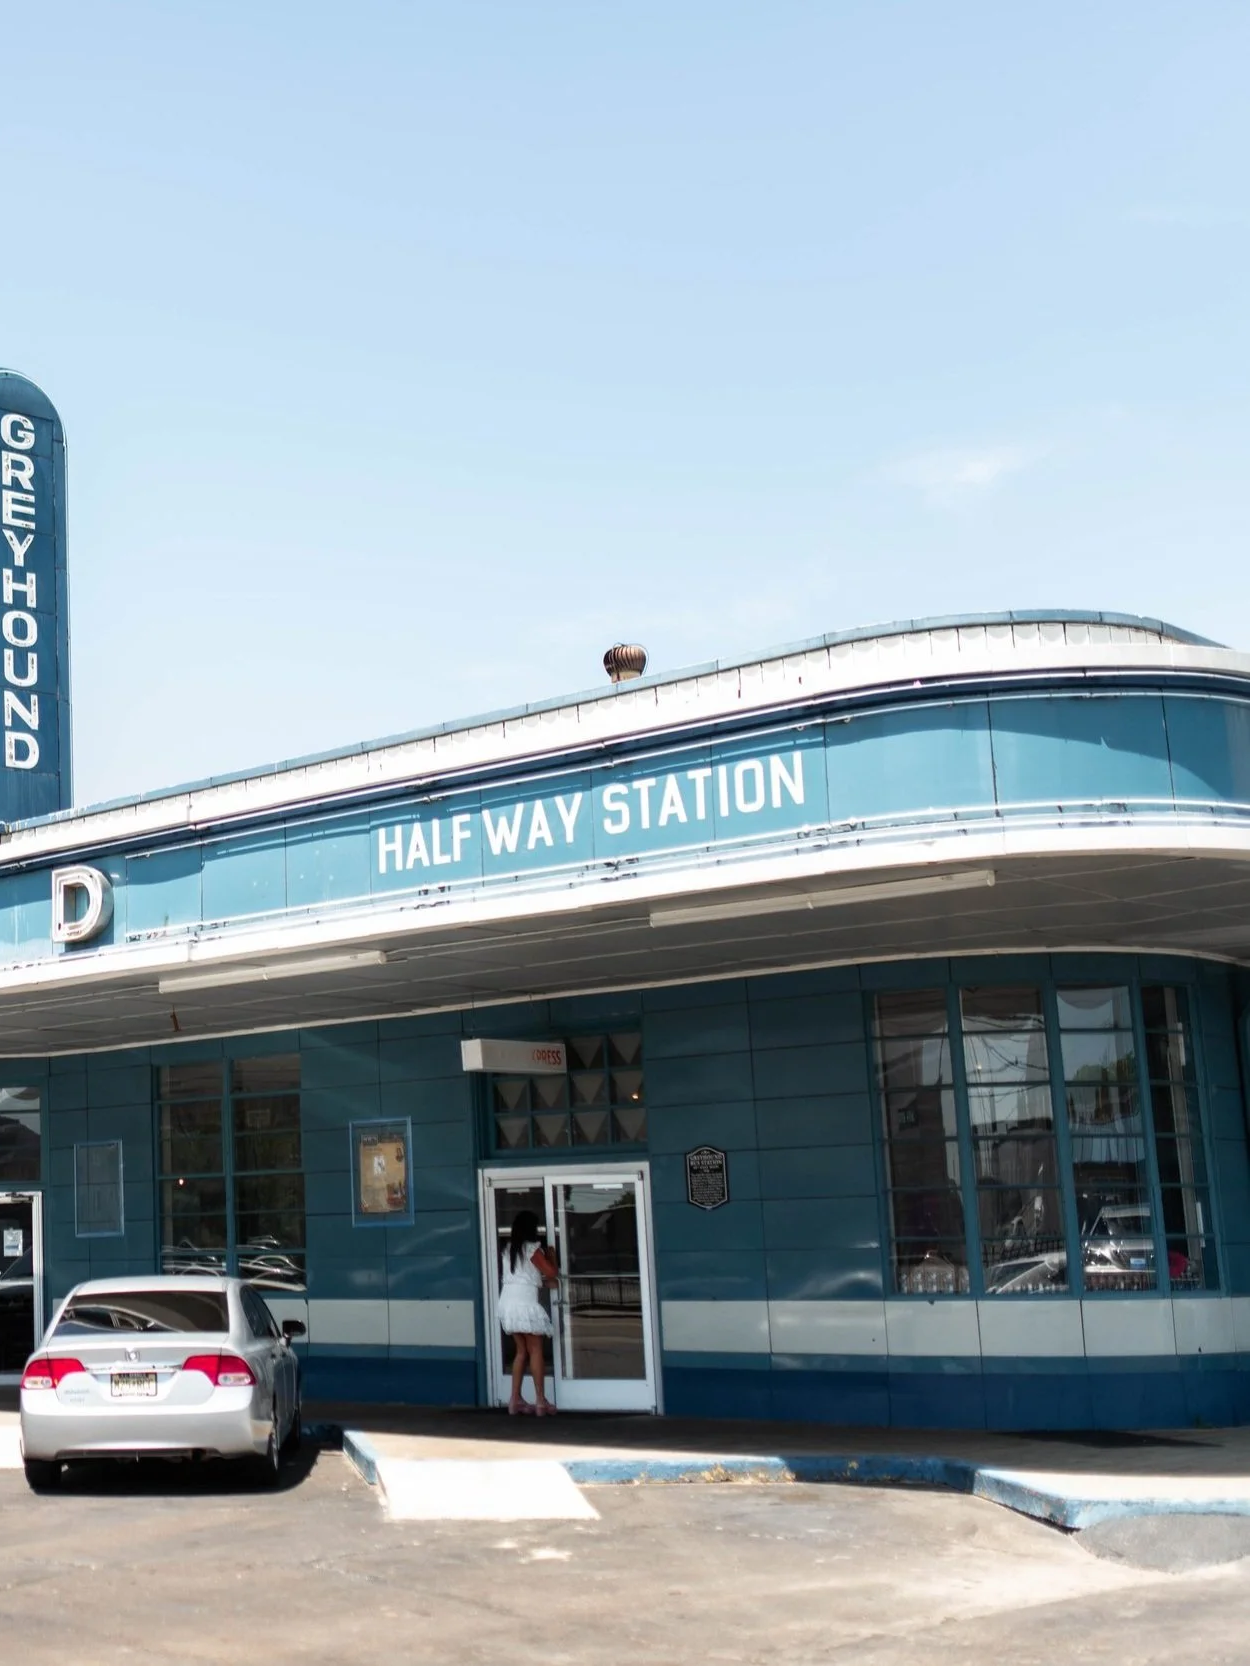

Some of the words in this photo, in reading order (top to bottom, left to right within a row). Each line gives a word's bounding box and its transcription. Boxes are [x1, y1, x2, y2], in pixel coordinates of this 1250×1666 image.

[0, 413, 41, 770] GREYHOUND
[377, 814, 471, 874] HALF
[481, 792, 583, 856] WAY
[602, 751, 805, 836] STATION
